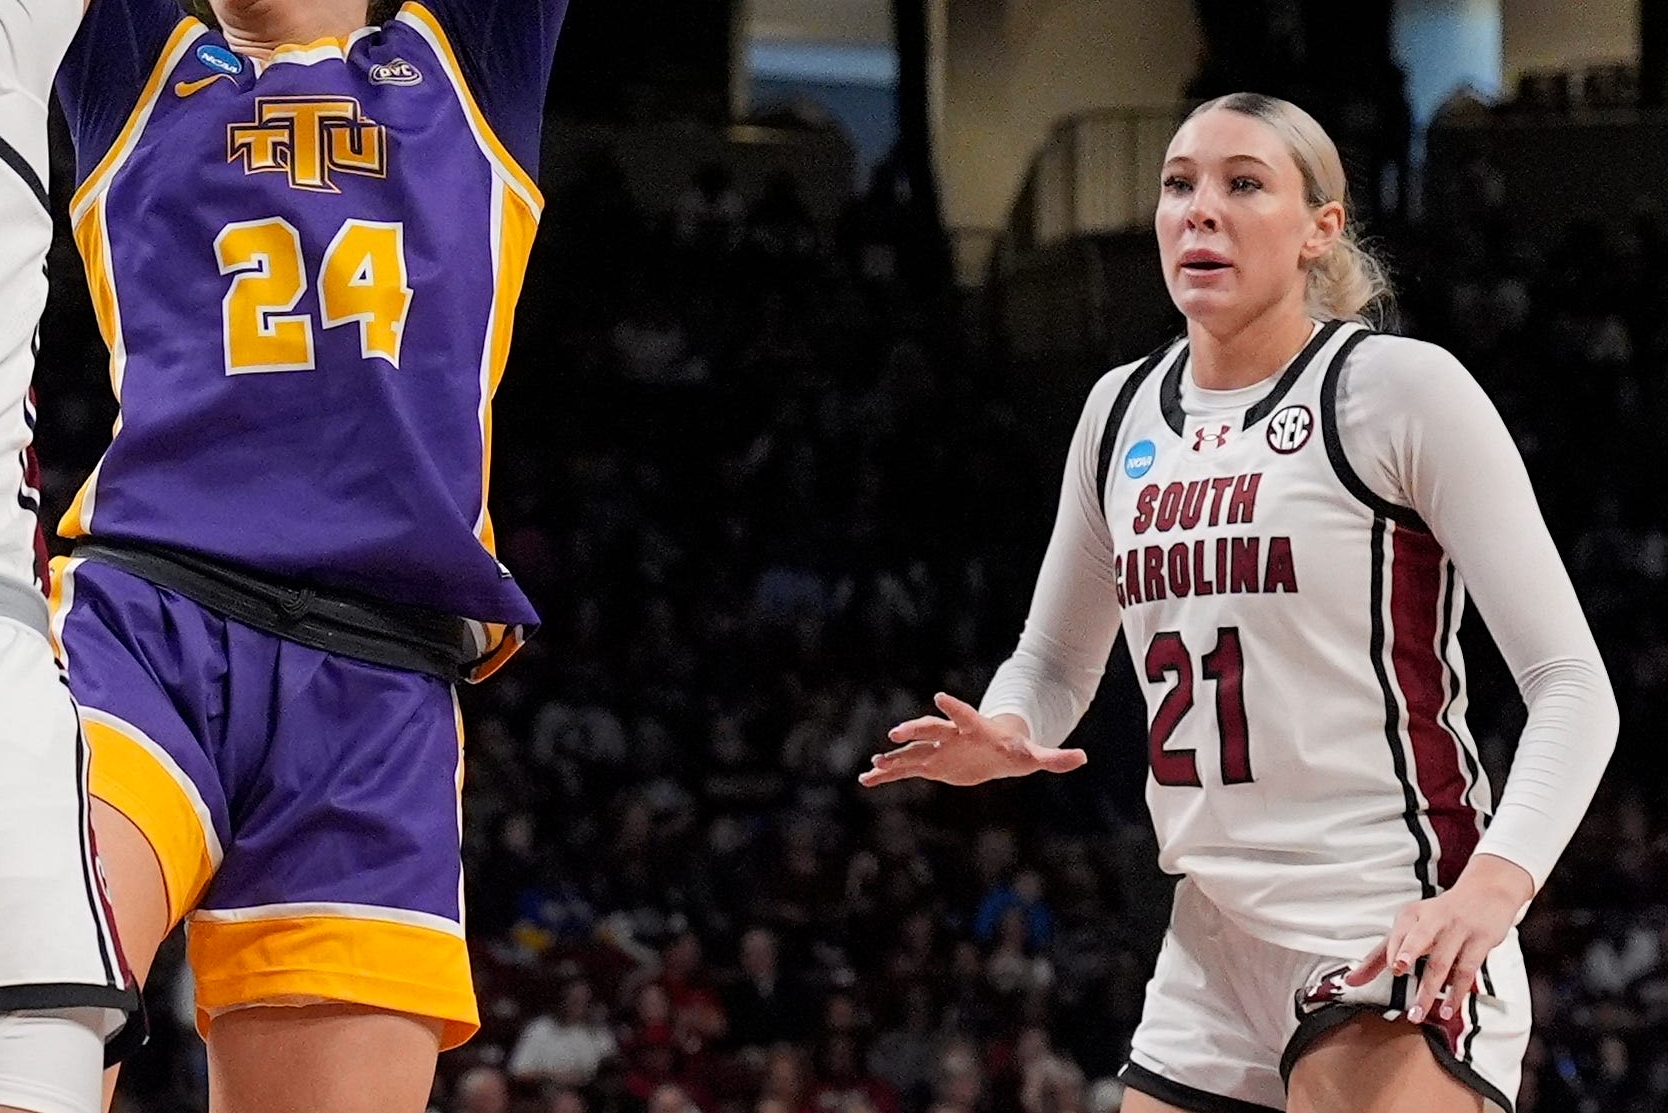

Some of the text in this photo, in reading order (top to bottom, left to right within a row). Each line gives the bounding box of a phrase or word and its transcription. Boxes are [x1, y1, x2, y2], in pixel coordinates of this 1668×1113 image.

[226, 95, 387, 193] TTU
[213, 216, 413, 376] 24
[1268, 406, 1311, 451] SEC
[1133, 473, 1261, 535] SOUTH
[1145, 626, 1255, 787] 21
